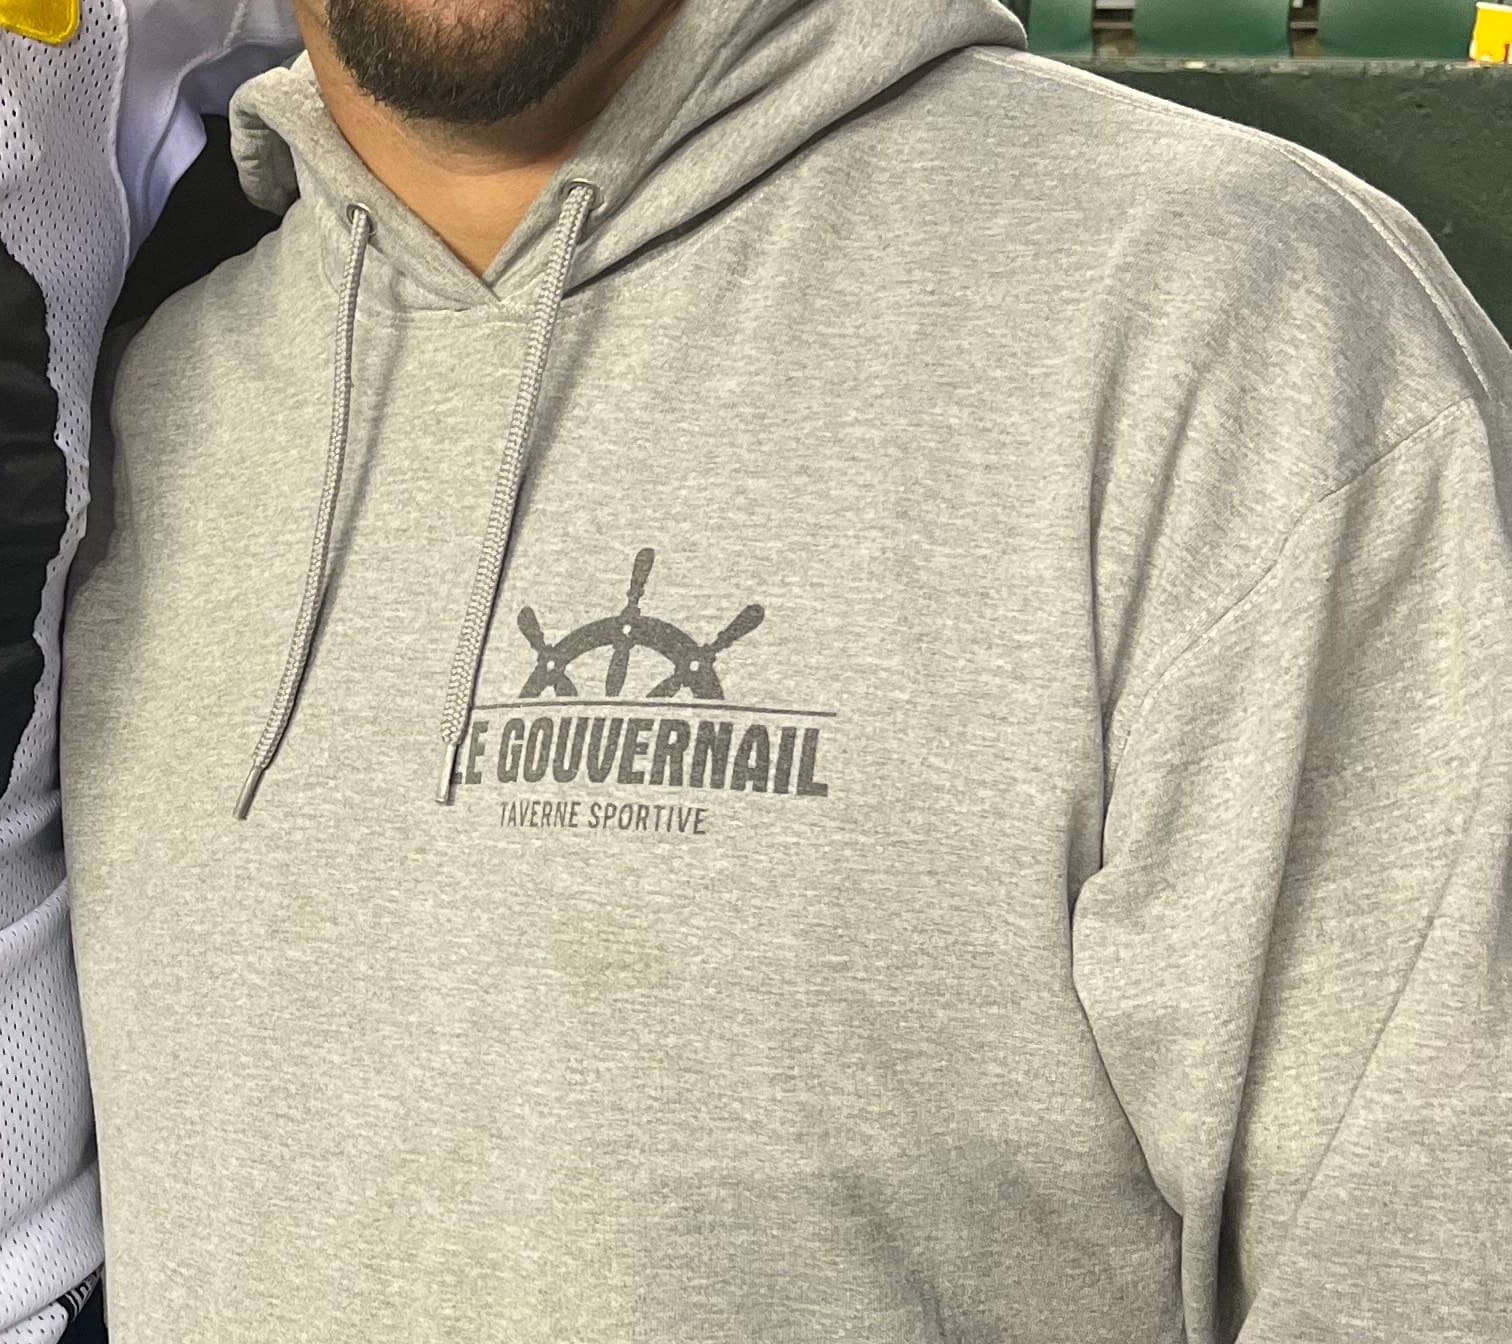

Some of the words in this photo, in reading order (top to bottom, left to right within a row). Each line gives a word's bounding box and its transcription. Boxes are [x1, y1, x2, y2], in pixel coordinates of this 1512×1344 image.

[450, 718, 489, 785] E
[497, 716, 829, 797] GOUVERNAIL
[499, 800, 582, 829] TAVERNE
[588, 801, 709, 835] SPORTIVE
